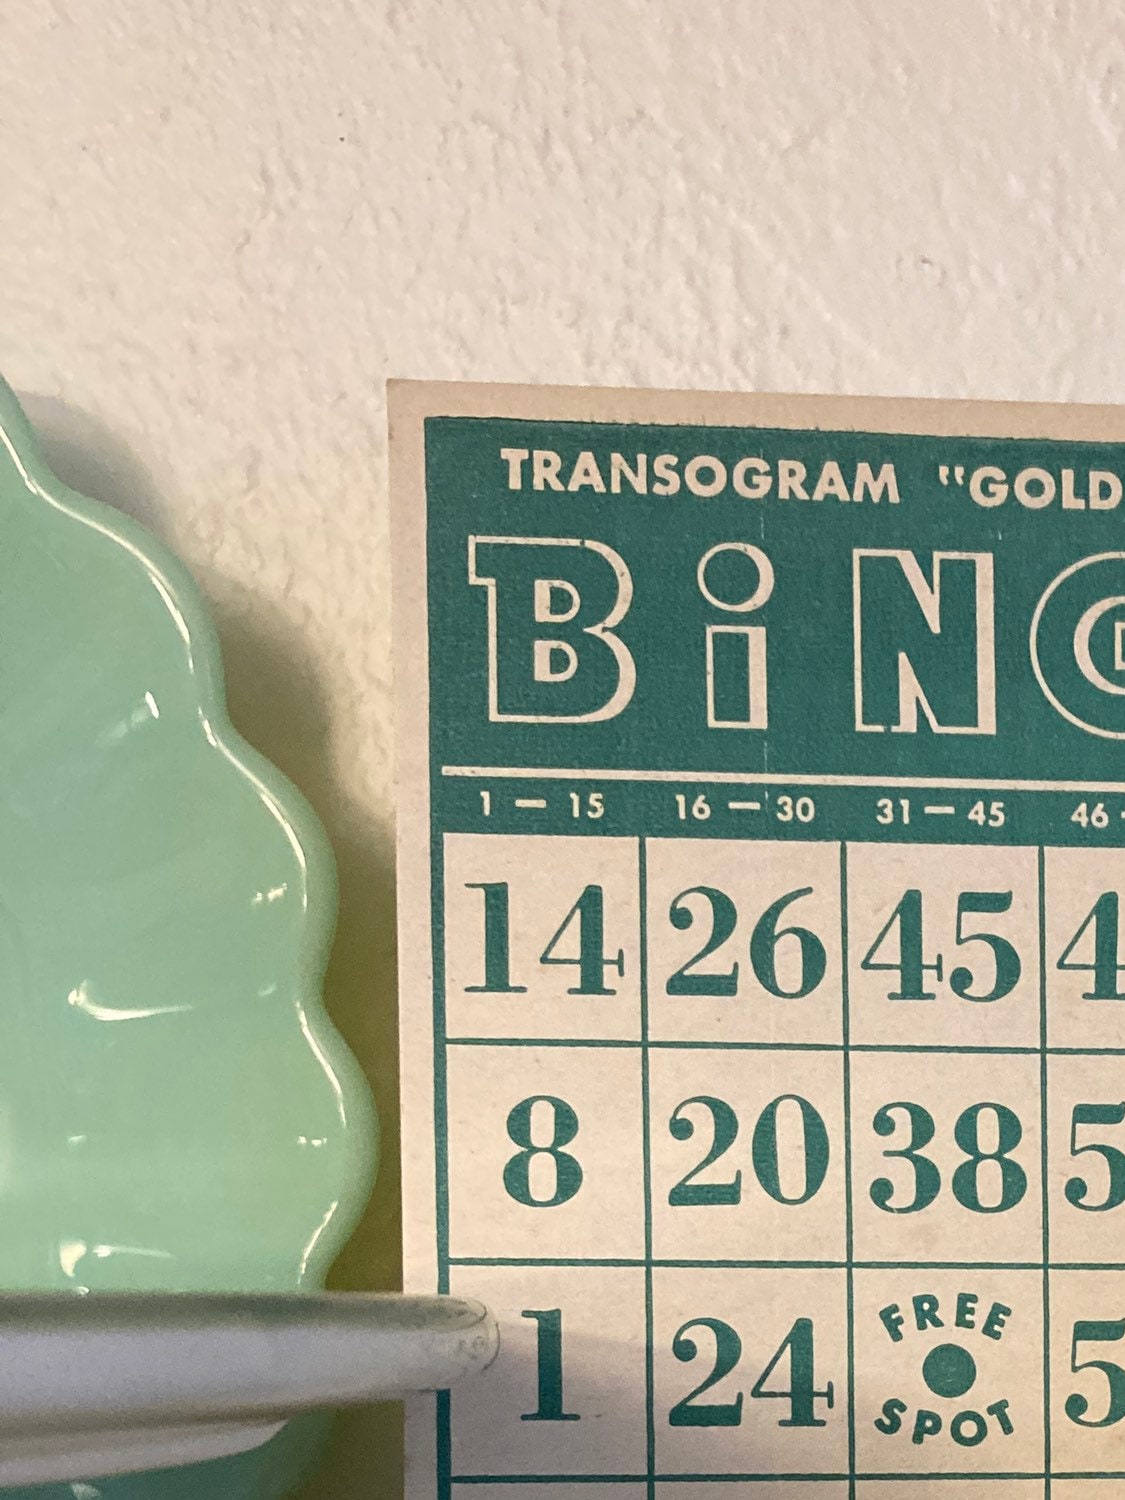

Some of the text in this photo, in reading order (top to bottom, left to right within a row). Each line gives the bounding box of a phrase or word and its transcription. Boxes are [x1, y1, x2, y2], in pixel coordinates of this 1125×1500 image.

[501, 448, 900, 503] TRANSOGRAM
[463, 882, 624, 996] 14
[666, 885, 828, 999] 26
[861, 889, 1022, 1003] 45
[503, 1095, 583, 1208] 8
[668, 1095, 831, 1207] 20
[869, 1101, 1029, 1214] 38
[879, 1292, 1012, 1342] FREE
[520, 1308, 581, 1421] 1
[668, 1317, 835, 1428] 24
[874, 1398, 1014, 1447] SPOT
